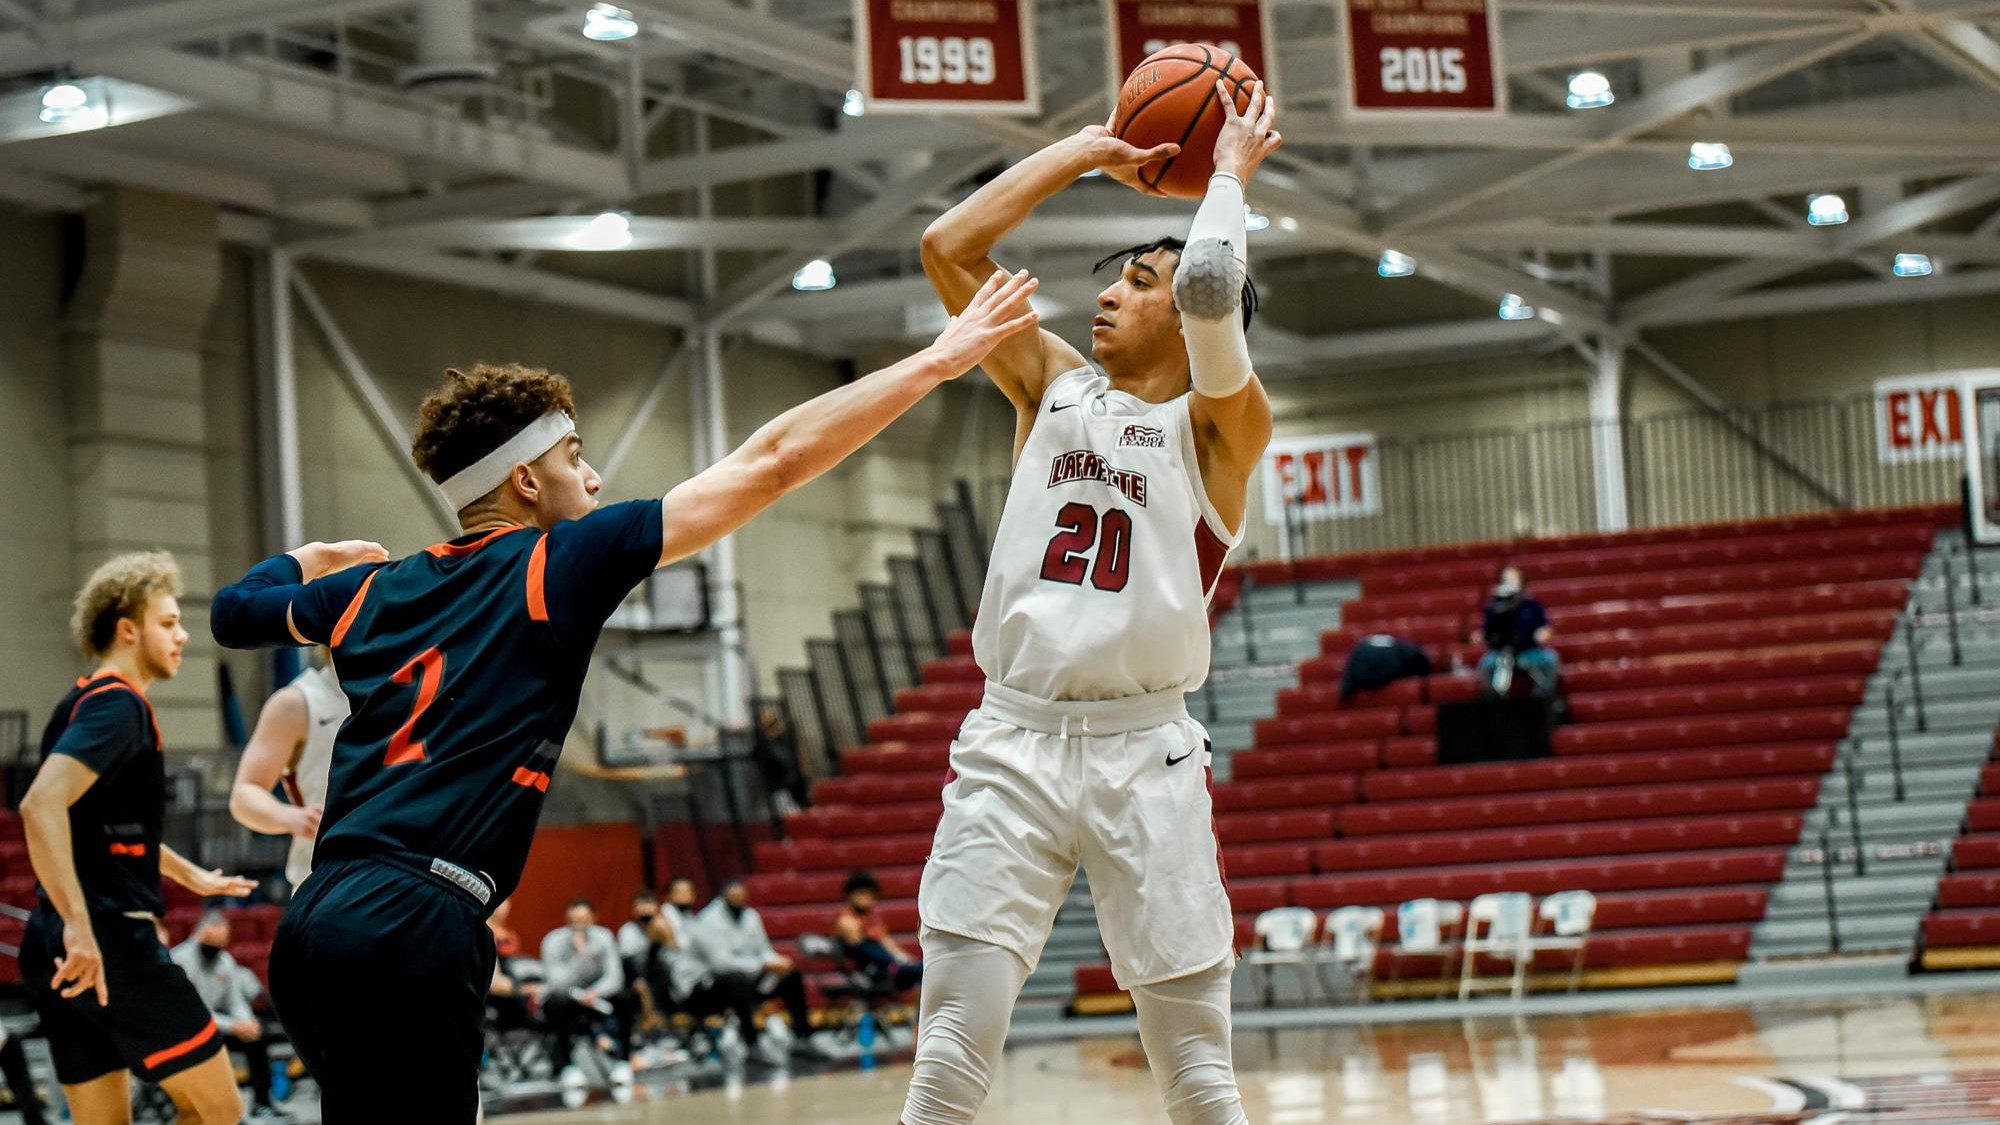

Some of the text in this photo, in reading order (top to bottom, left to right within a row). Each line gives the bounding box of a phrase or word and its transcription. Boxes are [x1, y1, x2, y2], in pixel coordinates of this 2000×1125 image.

[899, 36, 996, 84] 1999
[1380, 47, 1467, 93] 2015
[1886, 387, 1962, 449] EXI
[1040, 501, 1132, 592] 20
[383, 644, 446, 768] 2
